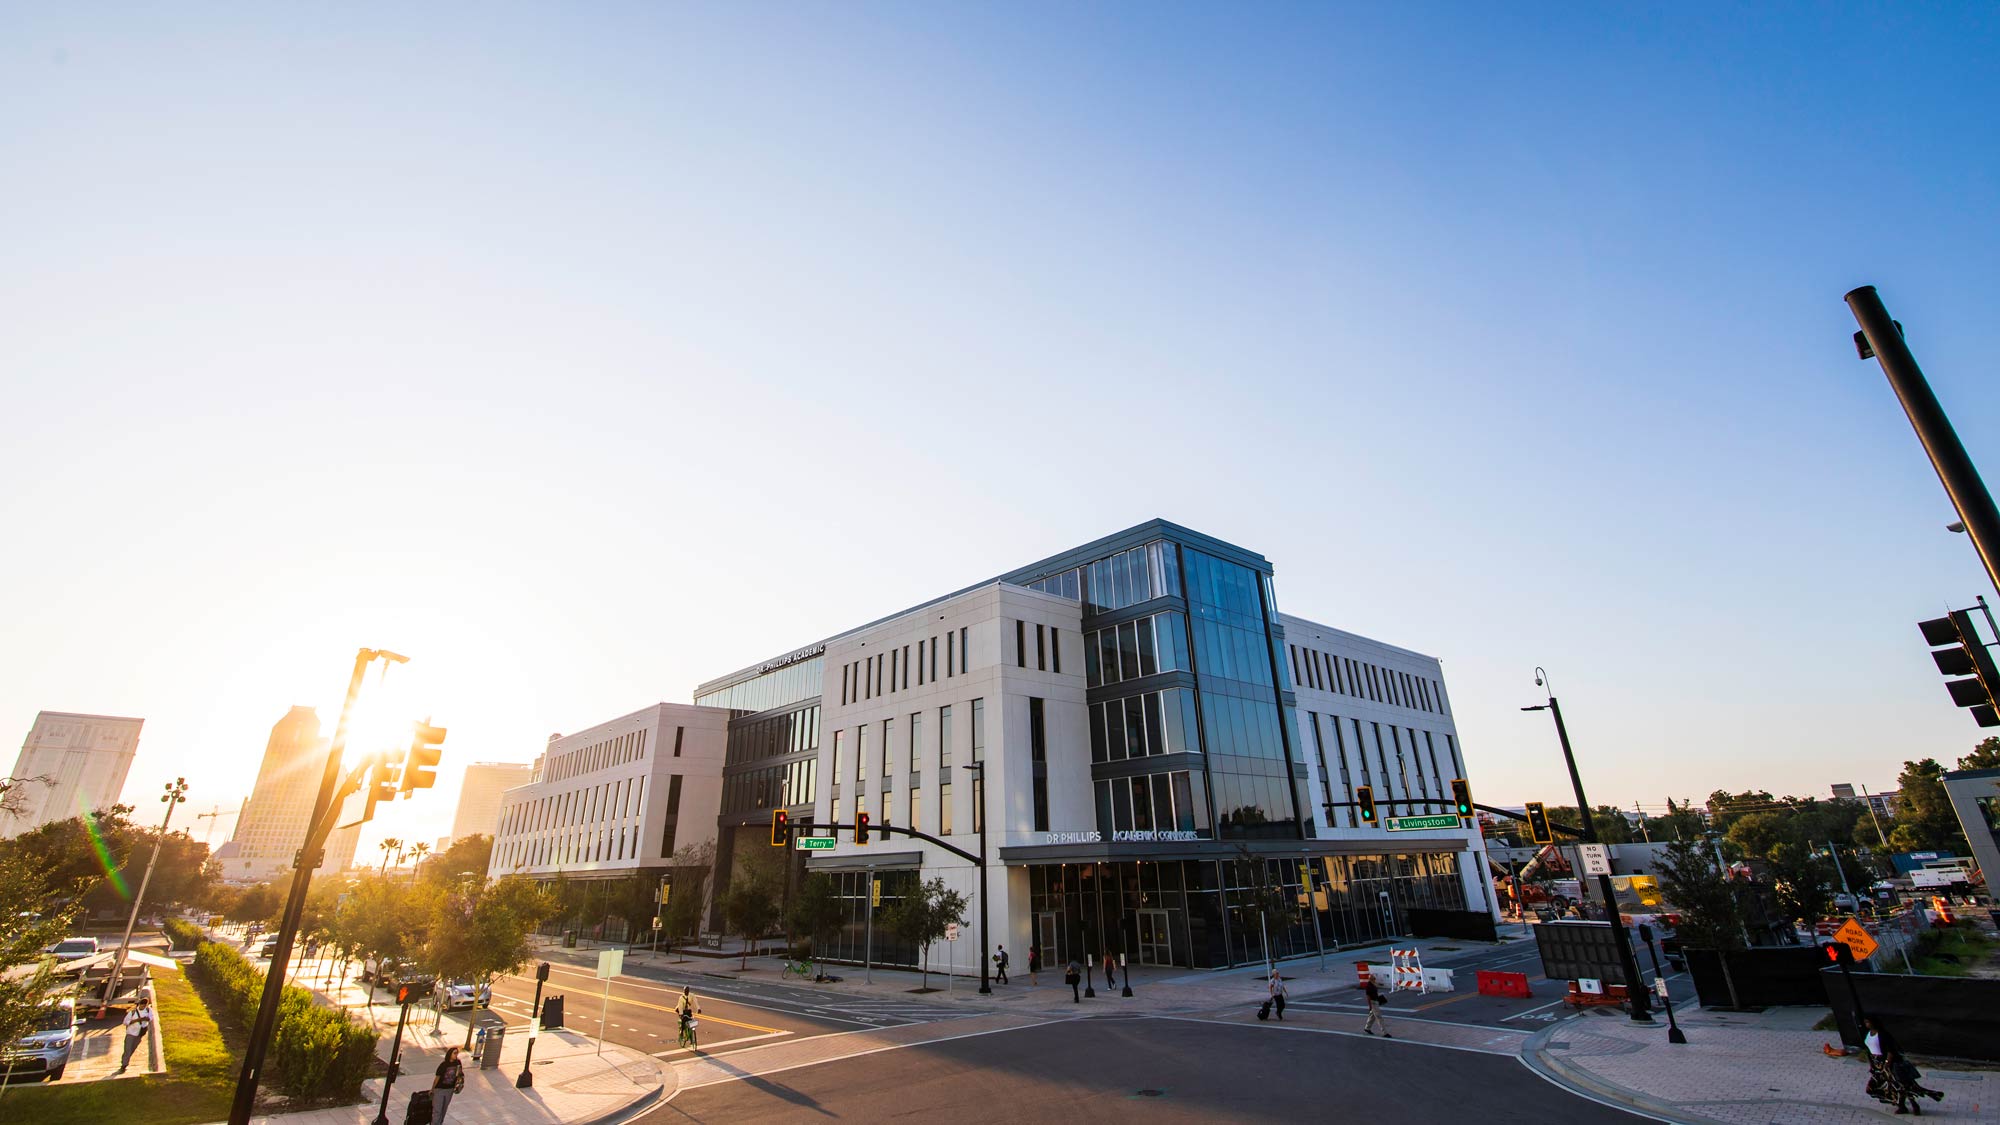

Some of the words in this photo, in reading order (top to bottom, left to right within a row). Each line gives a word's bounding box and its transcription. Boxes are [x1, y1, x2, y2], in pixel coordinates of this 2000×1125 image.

[793, 645, 824, 661] ACADEMIC
[1403, 819, 1446, 828] Livingston
[1061, 831, 1102, 843] PHILLIPS
[1112, 830, 1157, 842] ACADEMIC
[809, 840, 826, 849] Terry
[1845, 928, 1863, 937] ROAD
[1847, 937, 1865, 945] WORK
[1851, 945, 1869, 954] HEAD
